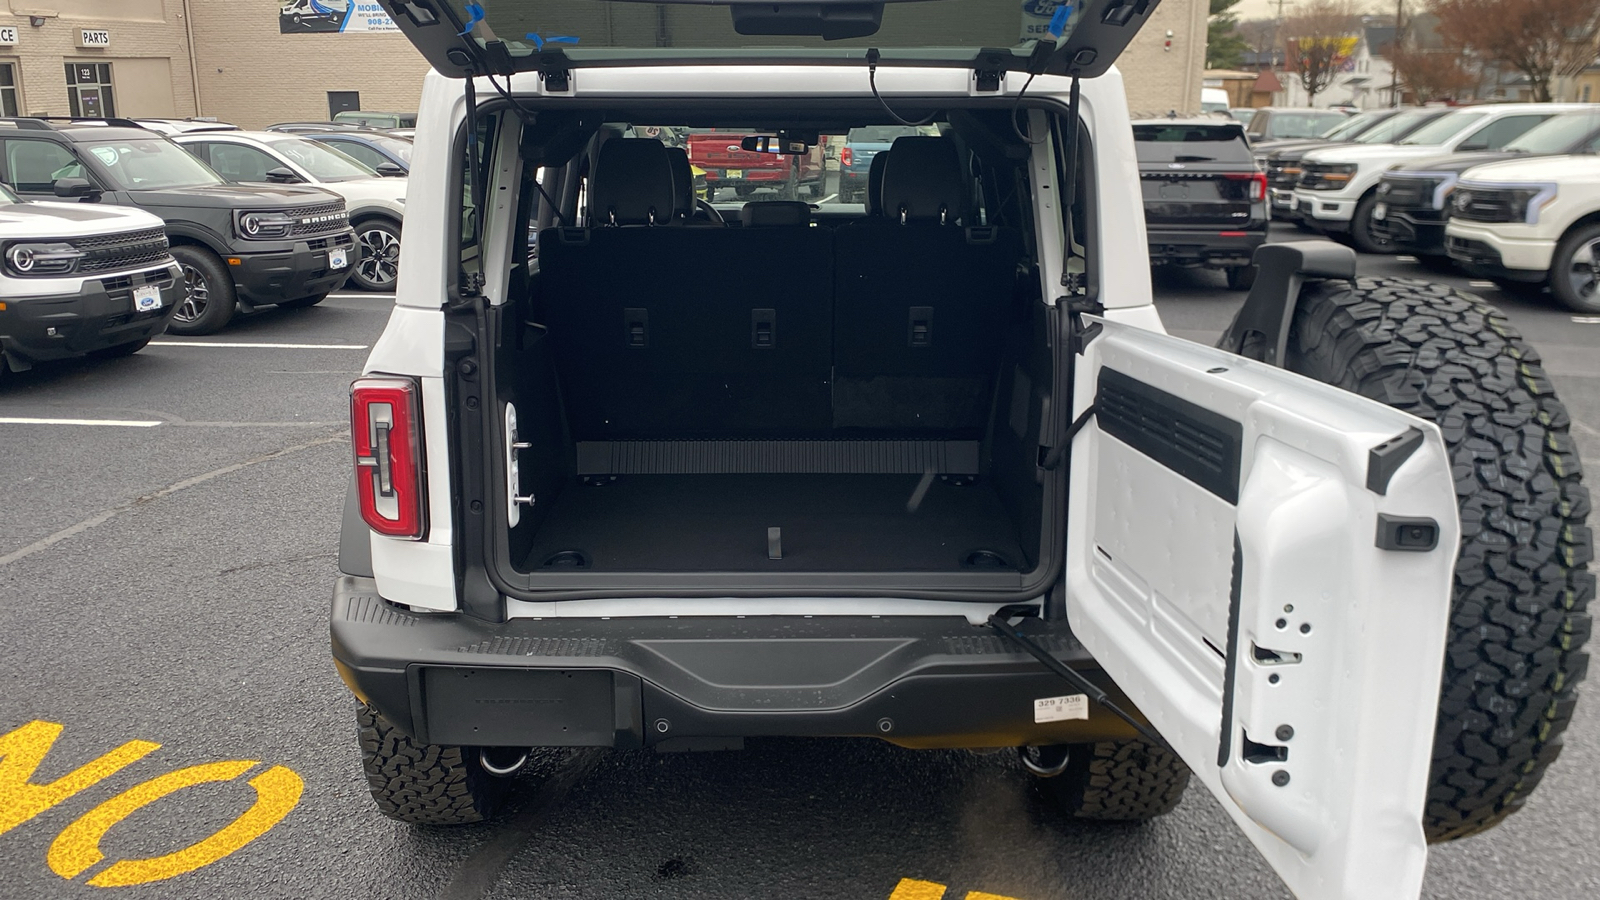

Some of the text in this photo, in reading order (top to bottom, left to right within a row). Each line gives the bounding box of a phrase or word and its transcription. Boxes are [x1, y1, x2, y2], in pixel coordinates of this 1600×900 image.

[83, 32, 109, 44] PARTS
[81, 68, 91, 76] 123
[302, 212, 347, 224] BRONCO
[1038, 696, 1081, 707] 329 7336
[0, 719, 304, 888] NO
